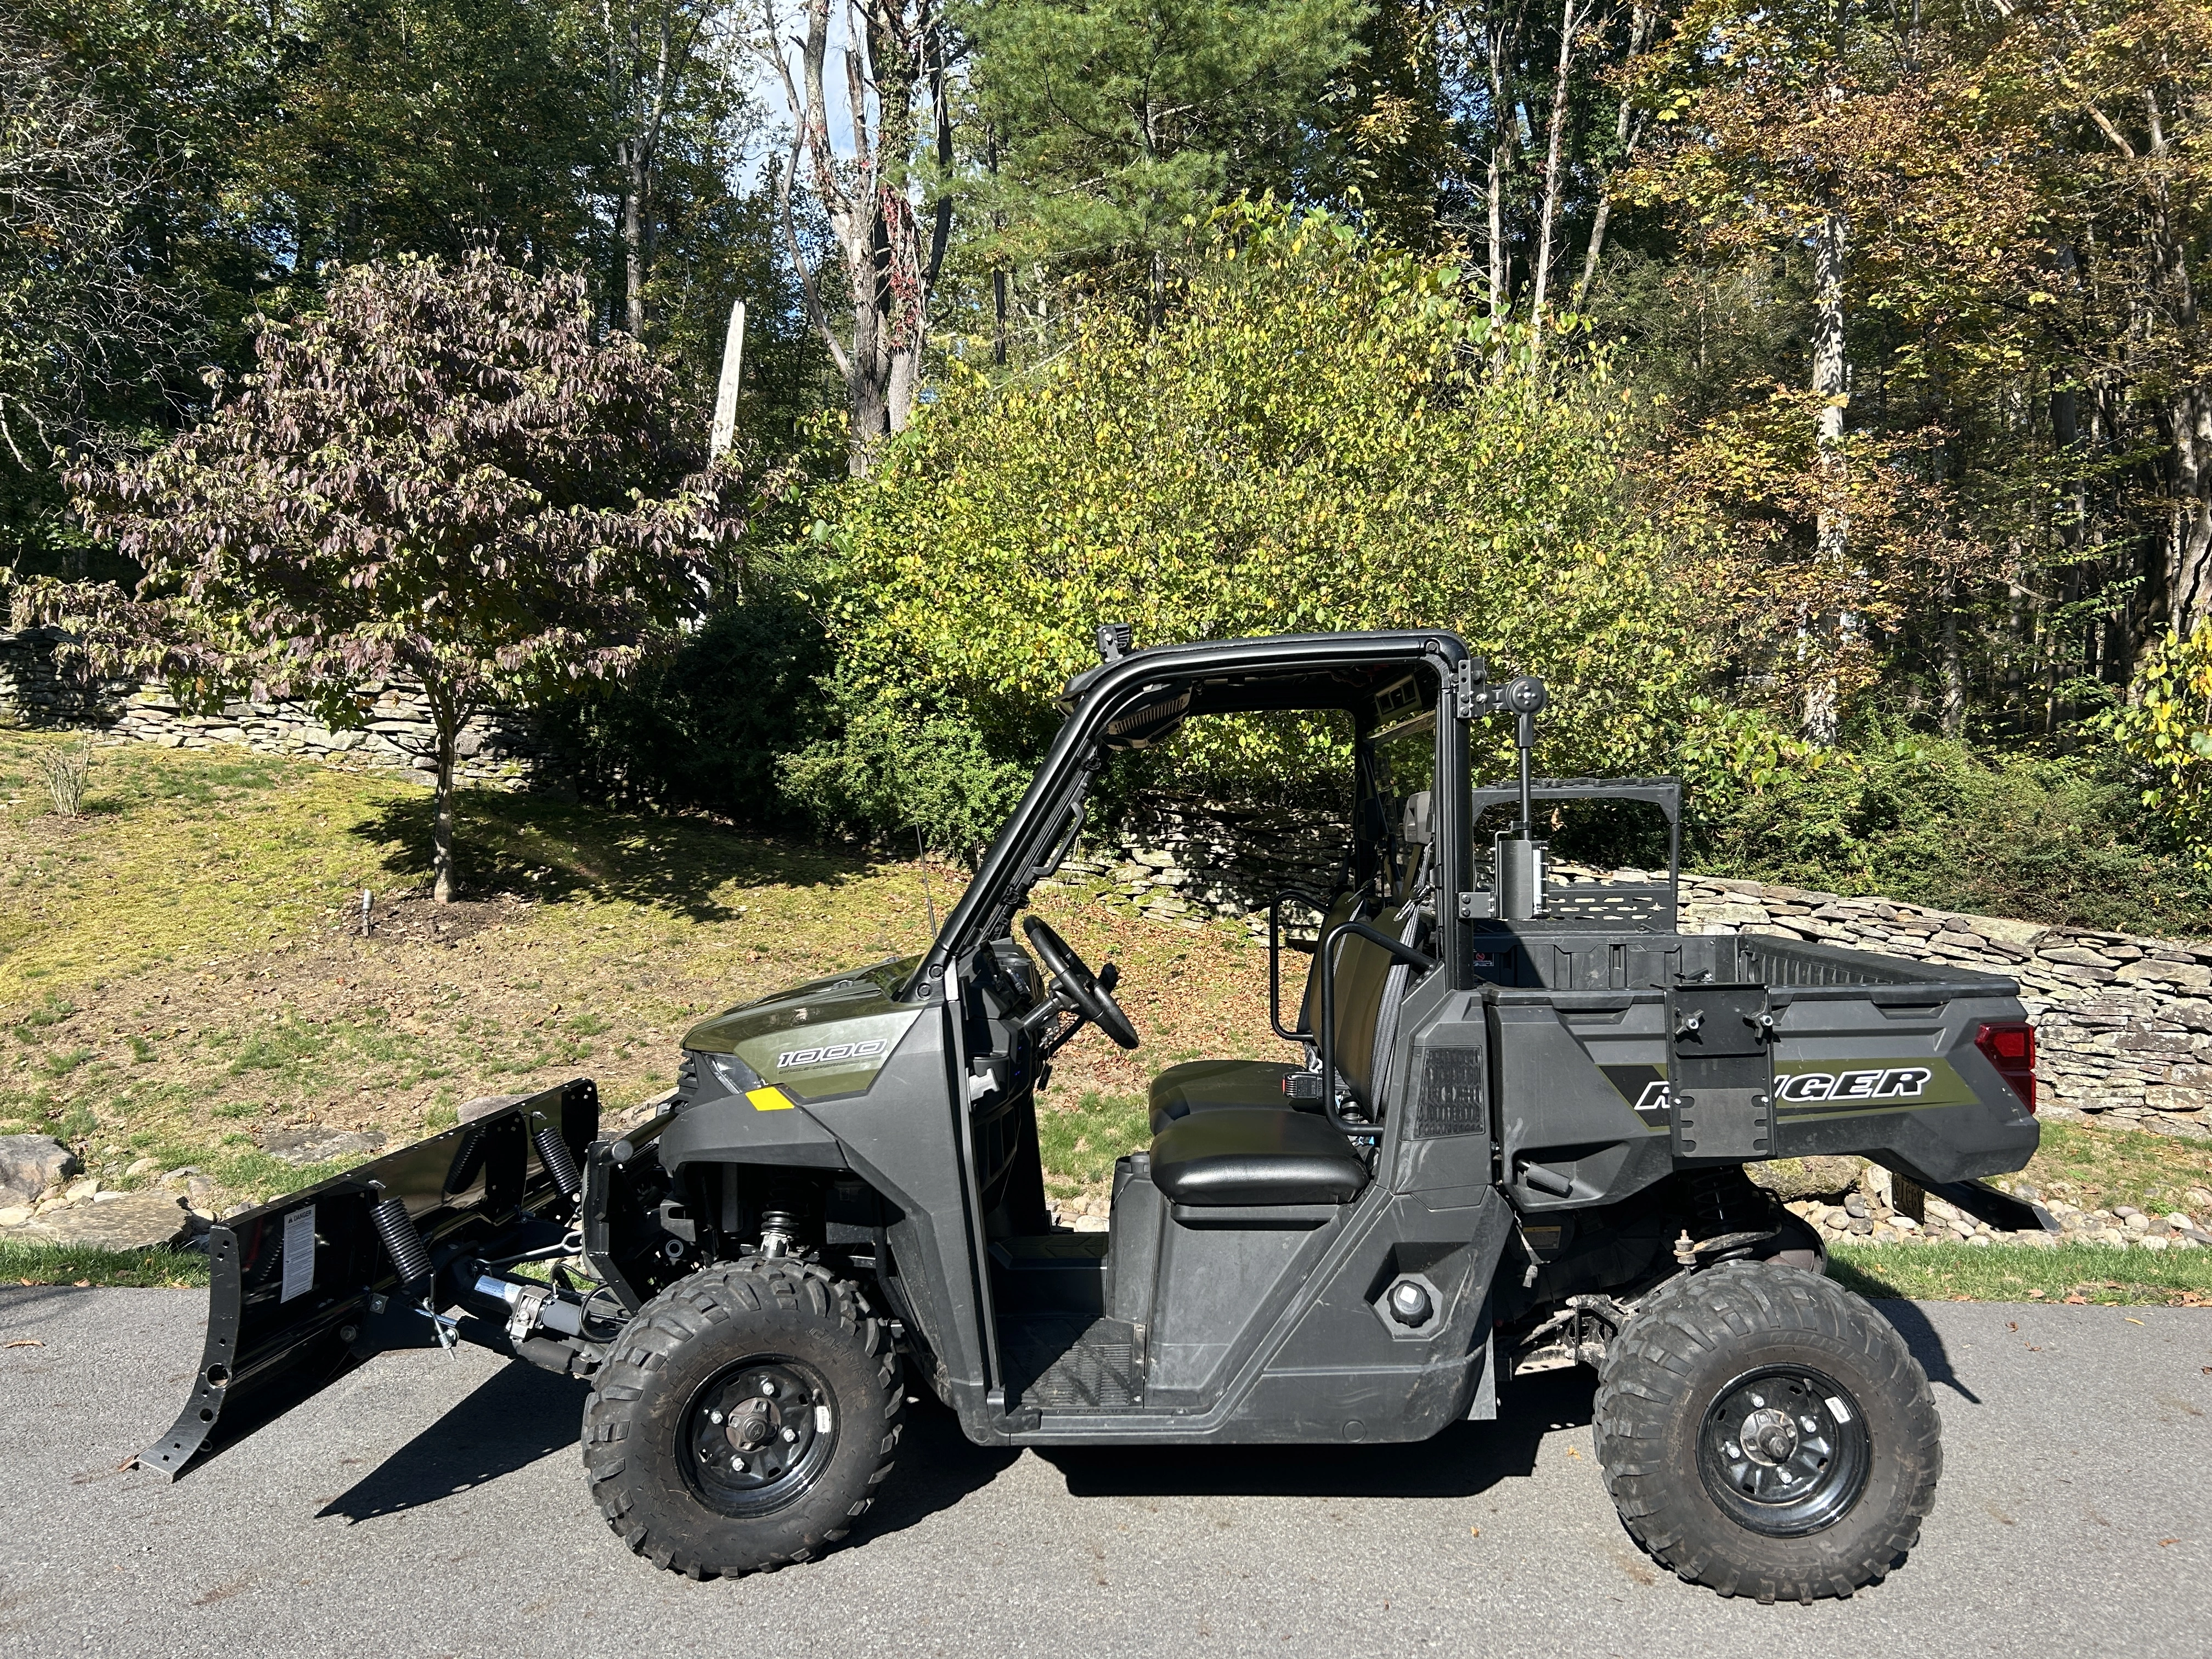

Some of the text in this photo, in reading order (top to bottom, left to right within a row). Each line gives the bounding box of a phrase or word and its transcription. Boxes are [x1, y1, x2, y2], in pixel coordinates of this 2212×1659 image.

[777, 1039, 887, 1068] 1000
[778, 1066, 810, 1075] SINGLE
[1634, 1067, 1932, 1110] RGER
[294, 1210, 312, 1221] DANGER
